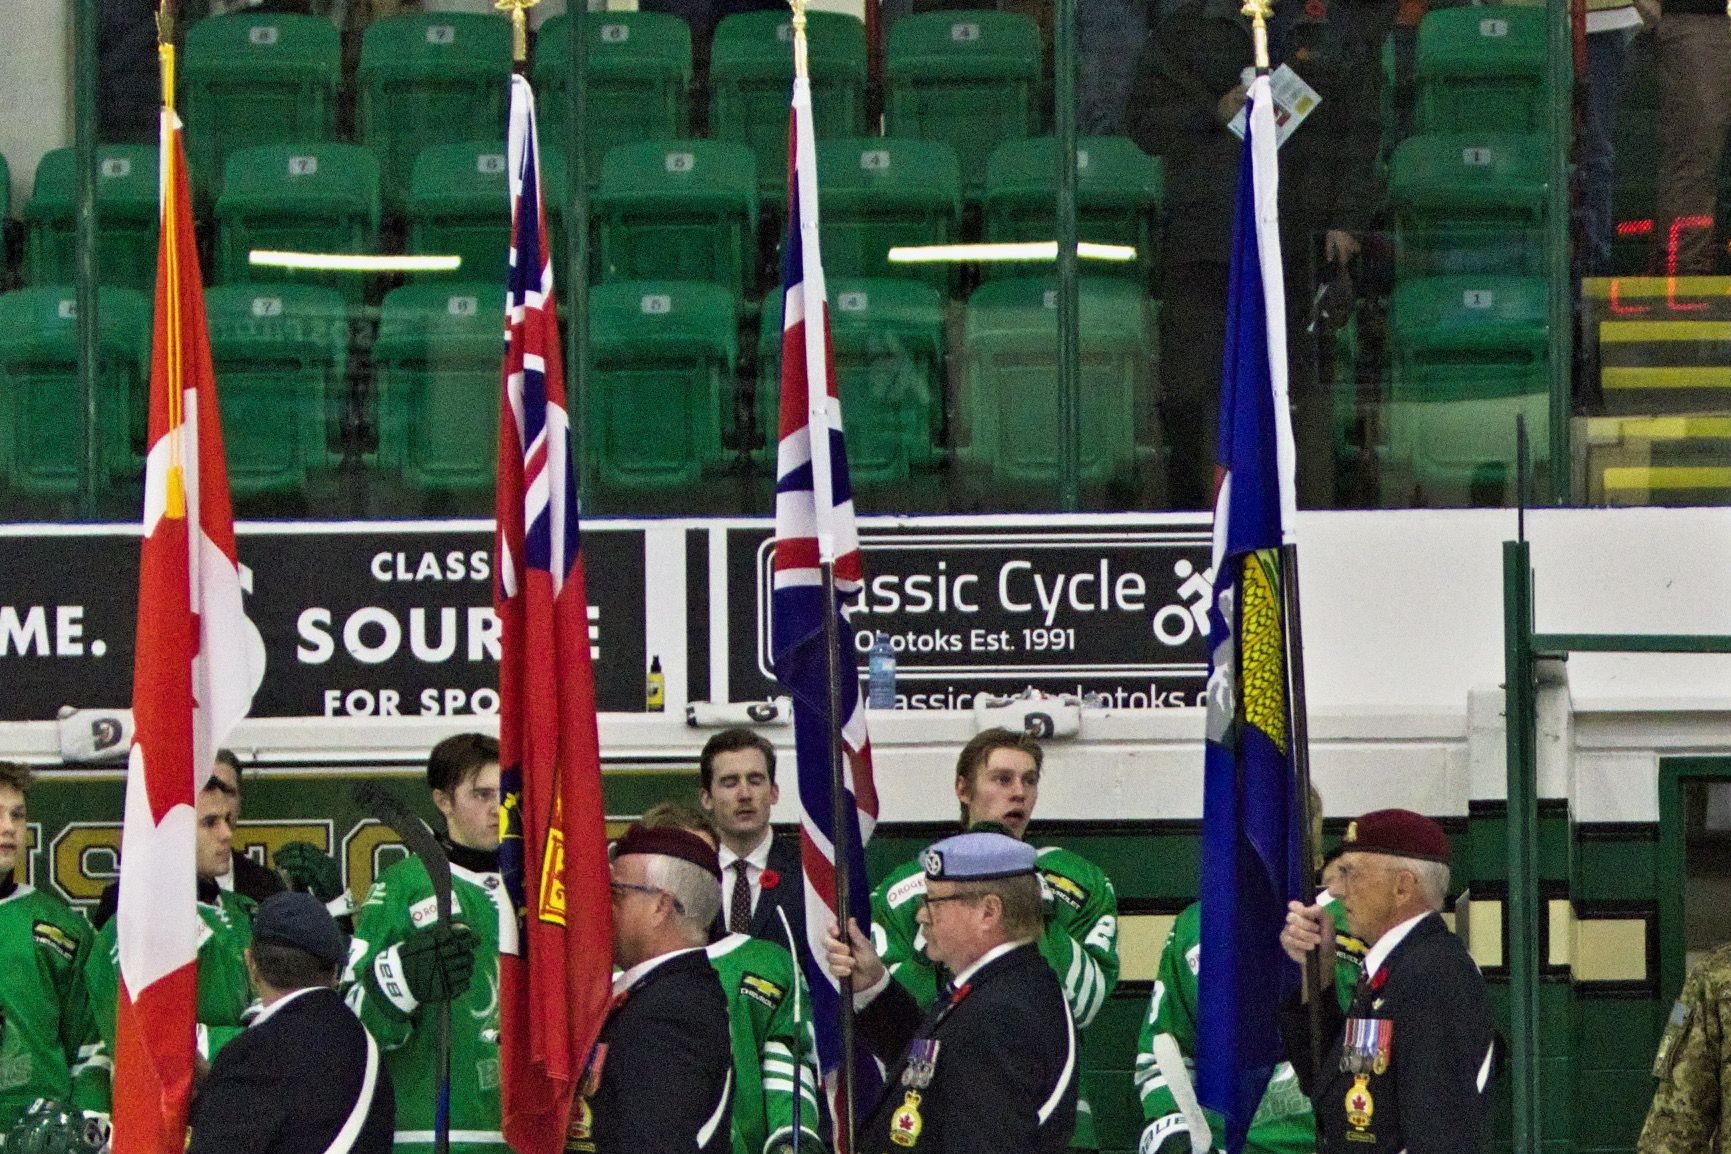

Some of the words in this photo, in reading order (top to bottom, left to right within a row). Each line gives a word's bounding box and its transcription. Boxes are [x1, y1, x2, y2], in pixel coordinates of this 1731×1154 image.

[371, 552, 490, 582] CLASS
[846, 560, 979, 613] assic
[1000, 558, 1146, 627] Cycle
[854, 628, 963, 653] Ootoks
[971, 631, 1015, 652] Est.
[1023, 629, 1075, 652] 1991
[324, 689, 401, 716] FOR
[420, 688, 500, 716] SPO
